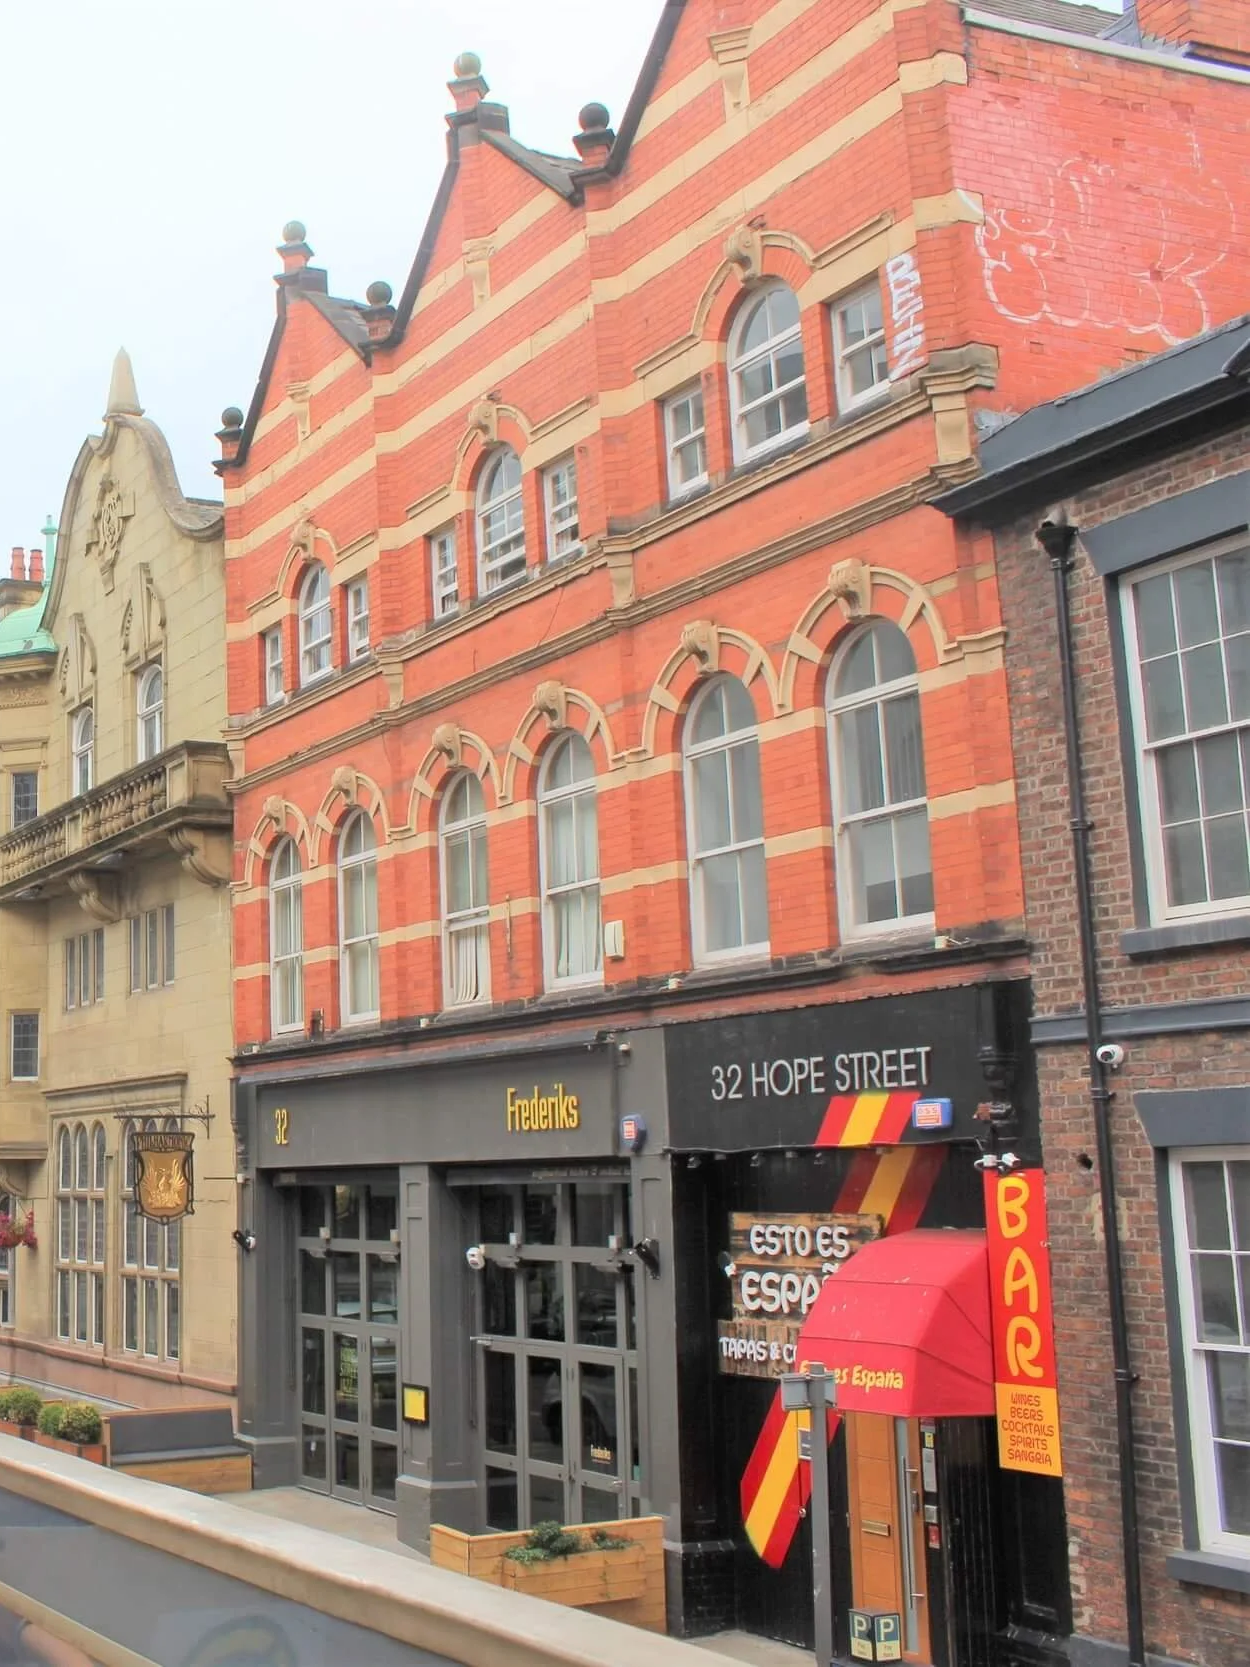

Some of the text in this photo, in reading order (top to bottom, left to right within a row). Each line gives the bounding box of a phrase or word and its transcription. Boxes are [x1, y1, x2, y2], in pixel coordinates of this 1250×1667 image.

[711, 1046, 932, 1101] 32 HOPE STREET
[507, 1083, 579, 1132] Frederiks
[274, 1108, 289, 1145] 32
[750, 1224, 850, 1258] ESTO ES
[741, 1262, 838, 1315] ESPA
[997, 1176, 1044, 1378] BAR
[718, 1336, 768, 1362] TAPAS
[769, 1344, 782, 1361] &
[852, 1365, 904, 1392] España
[1011, 1392, 1041, 1407] WINES
[1010, 1406, 1044, 1422] BEERS
[1001, 1420, 1055, 1437] COCKTAILS
[1010, 1434, 1048, 1451] SPIRITS
[1007, 1448, 1052, 1467] SANGRIA
[853, 1615, 867, 1637] P
[880, 1618, 894, 1640] P
